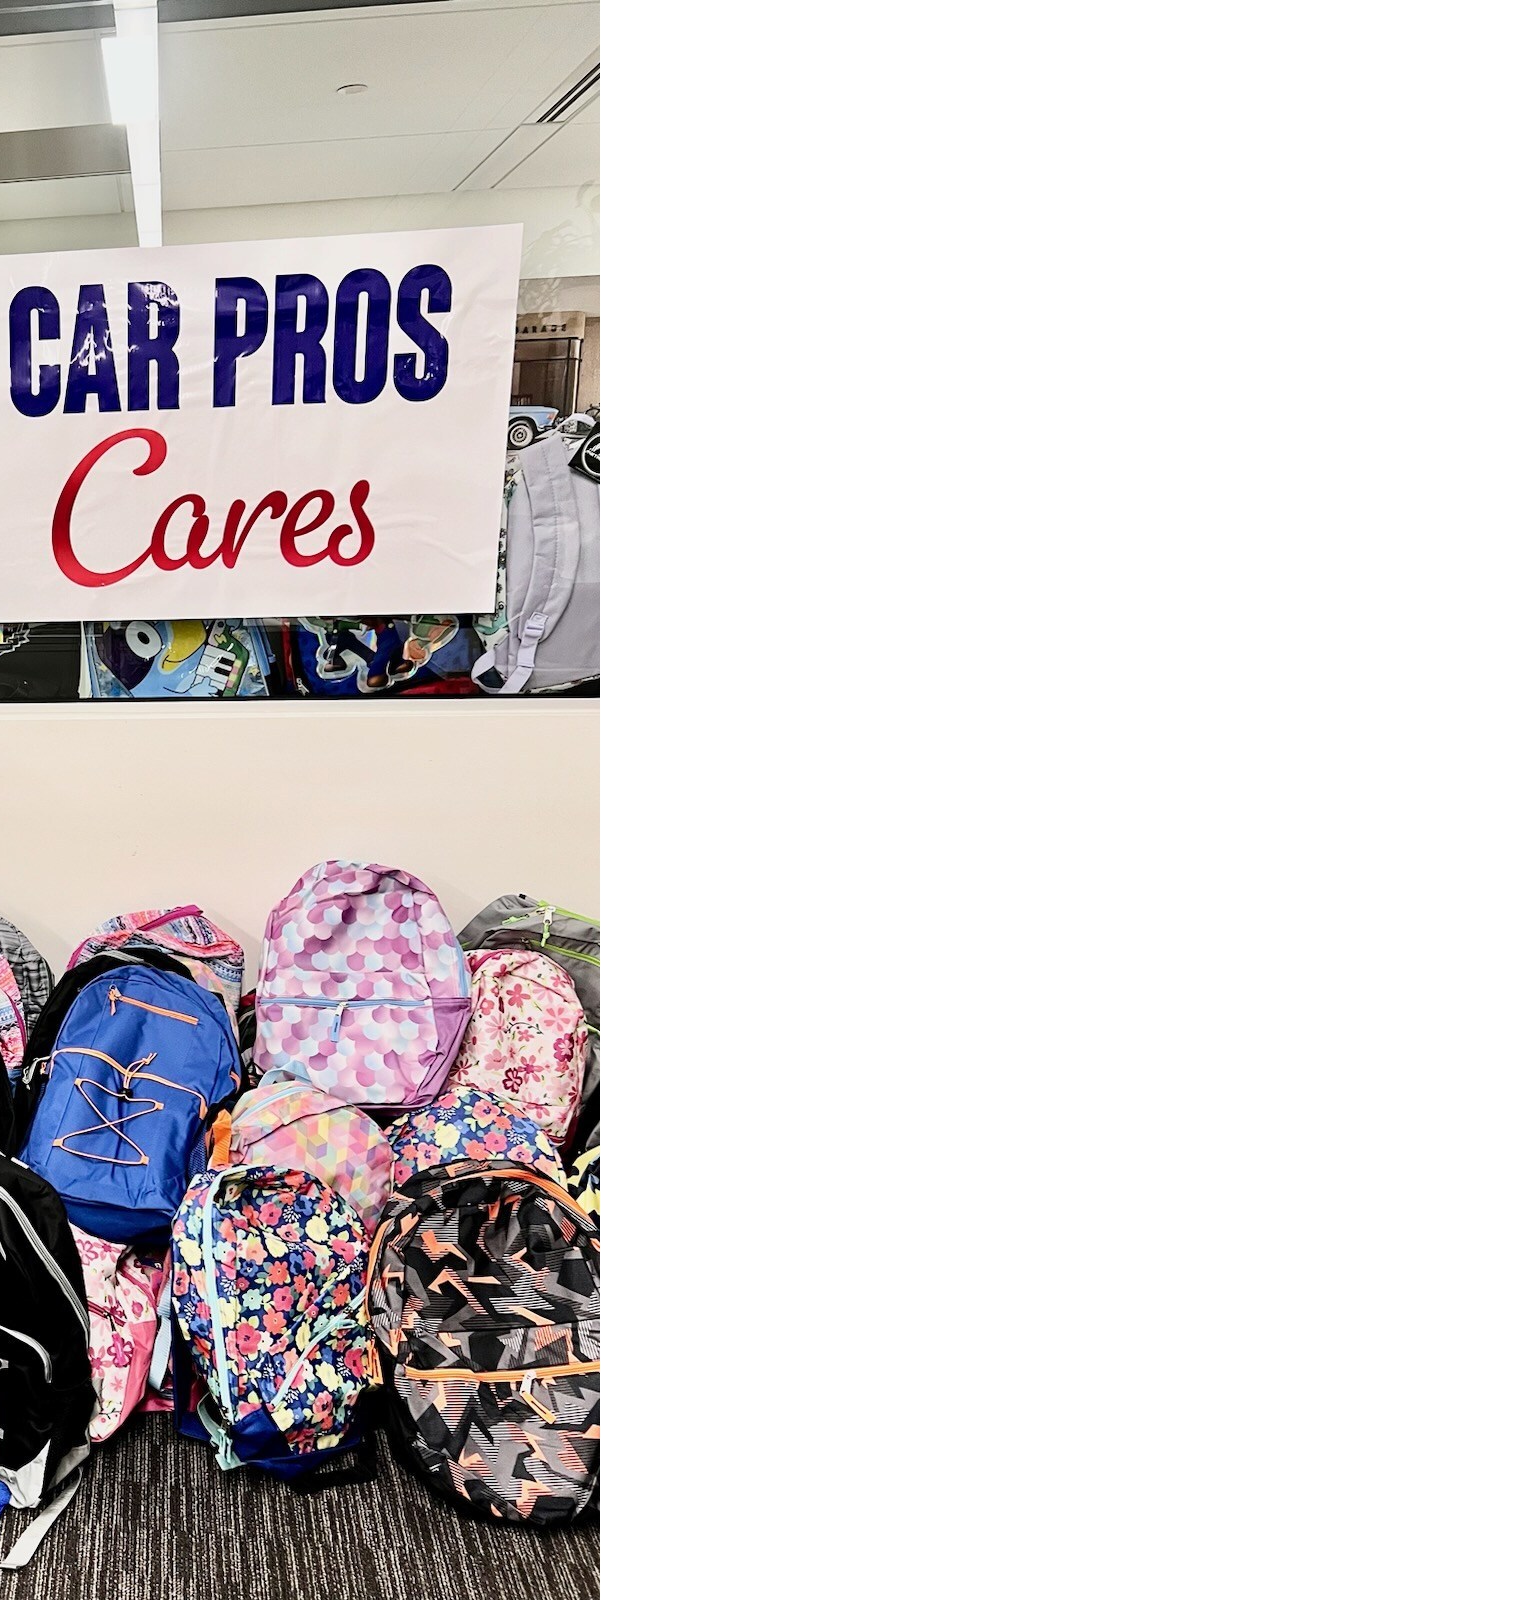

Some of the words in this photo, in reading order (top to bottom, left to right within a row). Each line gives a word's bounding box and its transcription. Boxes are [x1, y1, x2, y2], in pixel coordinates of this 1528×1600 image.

[9, 281, 180, 417] CAR
[213, 264, 452, 407] PROS
[52, 428, 375, 588] Cares
